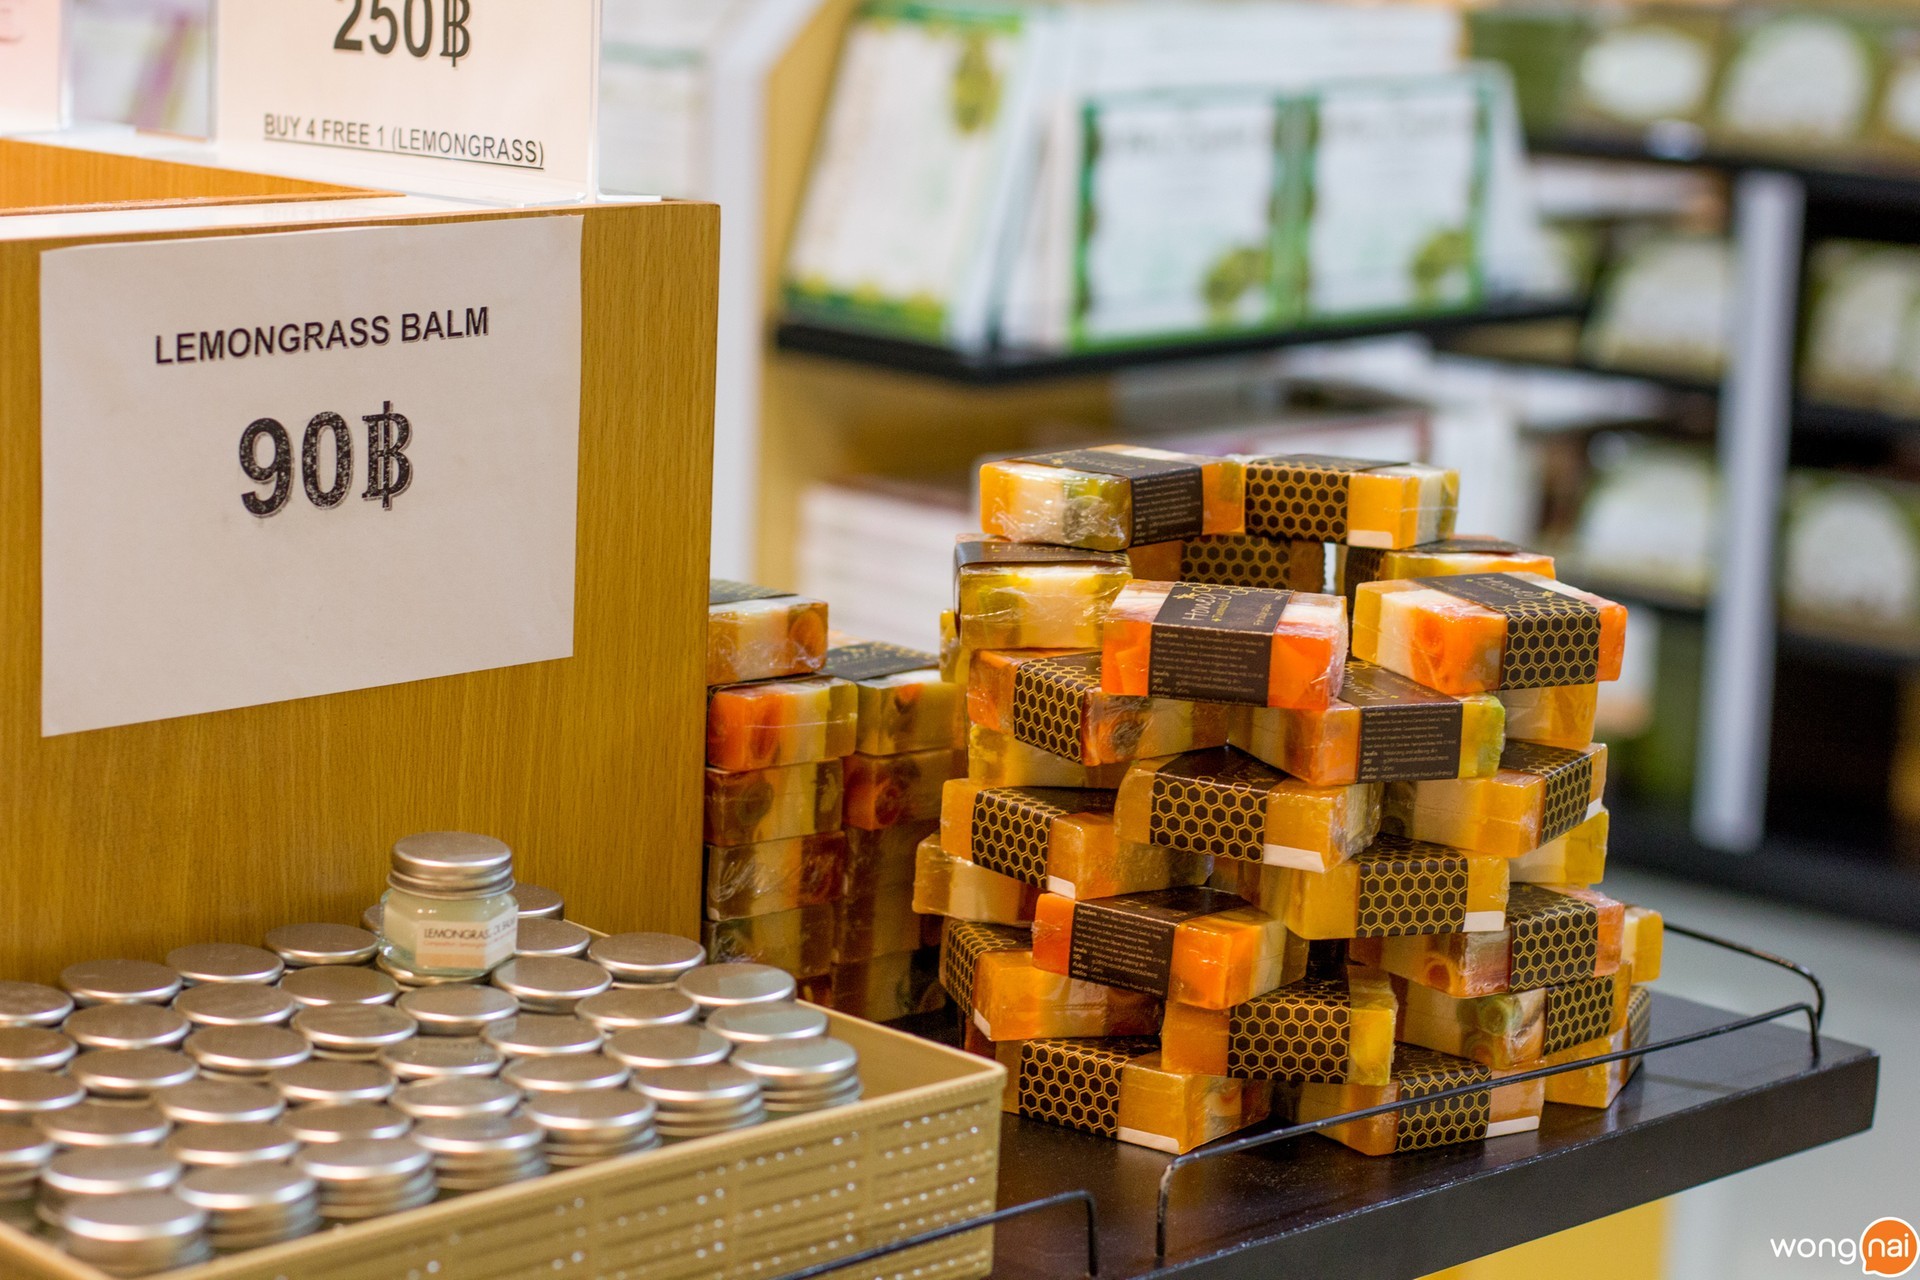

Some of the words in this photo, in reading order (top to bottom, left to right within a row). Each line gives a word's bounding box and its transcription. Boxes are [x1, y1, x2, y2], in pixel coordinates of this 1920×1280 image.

[264, 113, 301, 138] BUY
[306, 118, 316, 138] 4
[322, 119, 370, 146] FREE
[376, 126, 385, 147] 1
[391, 127, 545, 168] (LEMONGRASS)
[155, 314, 391, 365] LEMONGRASS
[401, 306, 489, 343] BALM
